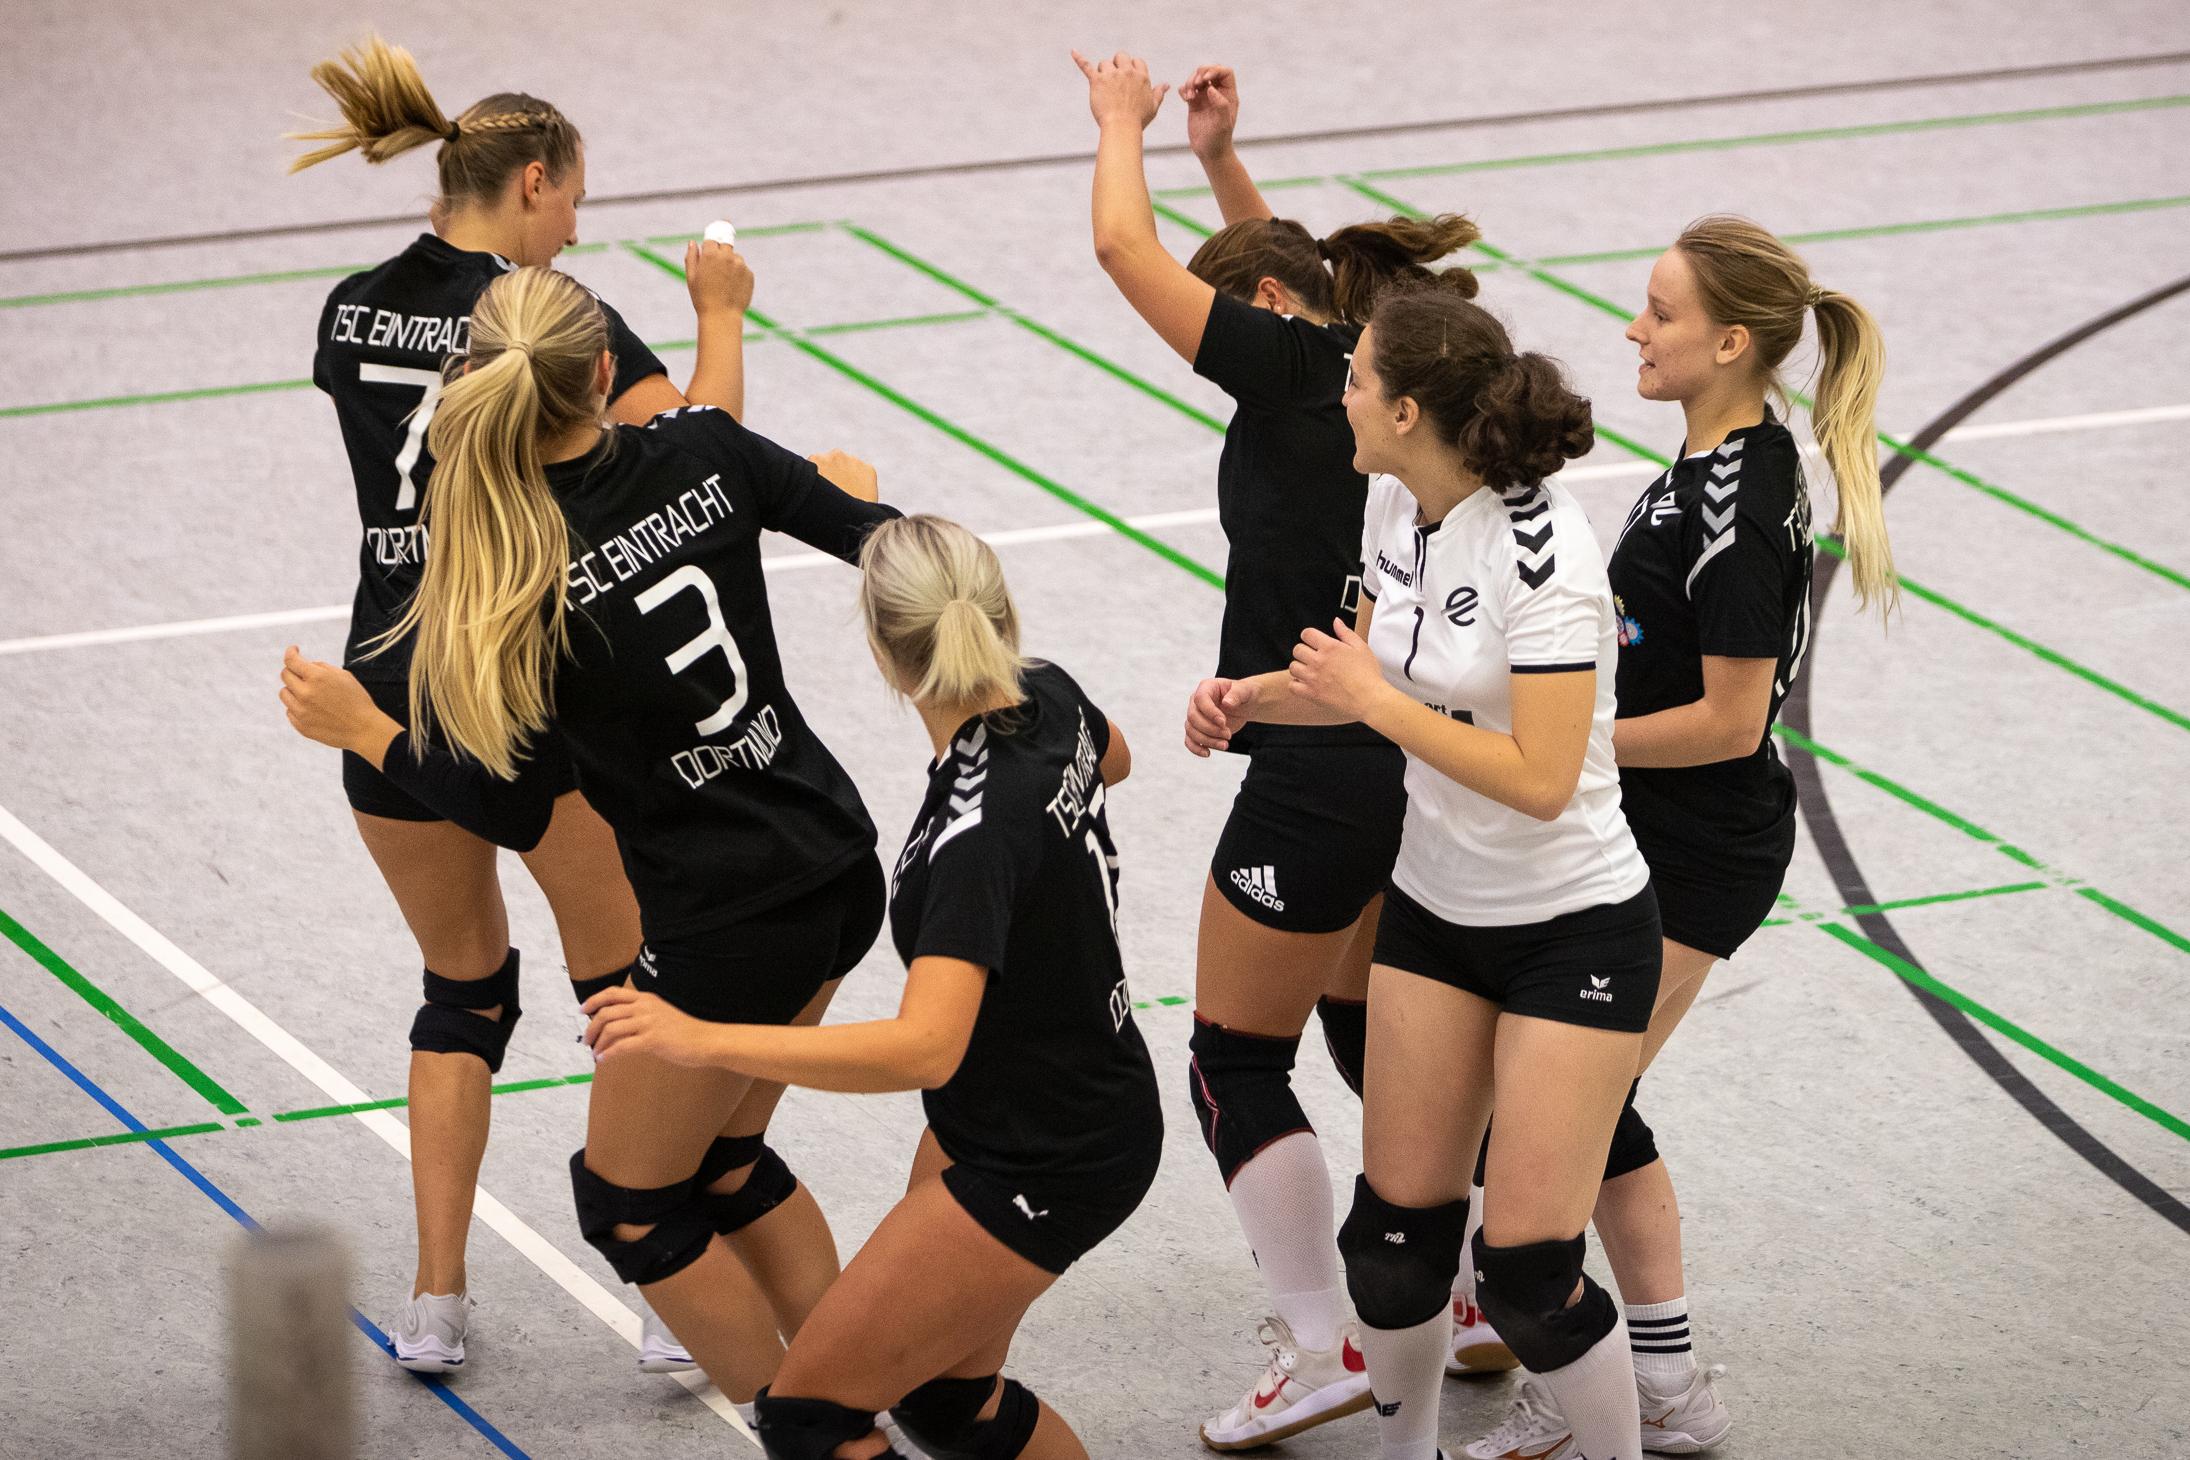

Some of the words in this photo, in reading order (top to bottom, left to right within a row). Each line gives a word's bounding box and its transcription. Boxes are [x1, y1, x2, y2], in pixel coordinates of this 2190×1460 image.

[331, 304, 371, 346] TSC
[367, 310, 472, 354] EINTRAC
[359, 362, 442, 511] 7
[564, 551, 614, 612] SC
[600, 473, 734, 582] EINTRACHT
[1376, 549, 1414, 589] hummel
[633, 563, 749, 737] 3
[1230, 869, 1285, 912] adidas
[1580, 989, 1613, 1002] erima
